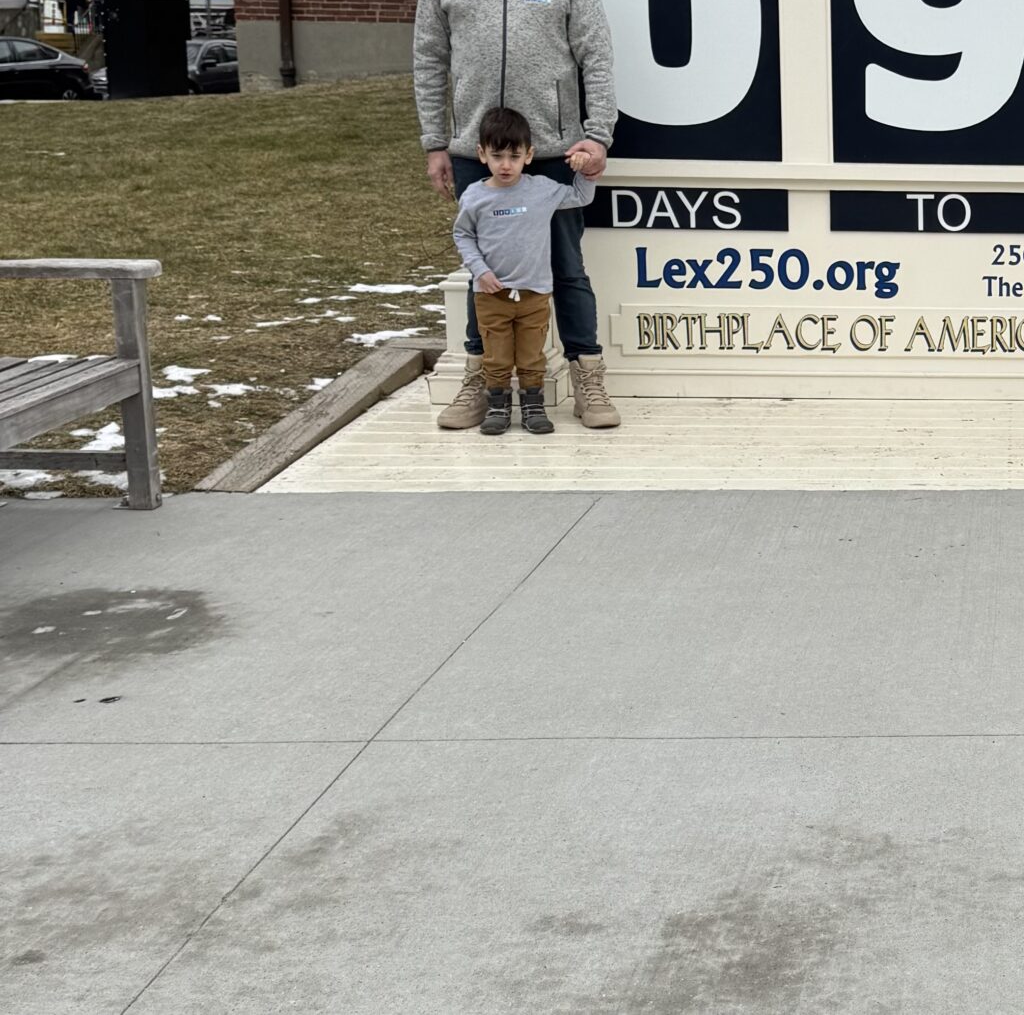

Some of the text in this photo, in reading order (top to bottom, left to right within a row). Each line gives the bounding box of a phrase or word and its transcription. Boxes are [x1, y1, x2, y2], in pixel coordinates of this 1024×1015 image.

[610, 189, 742, 230] DAYS
[906, 193, 972, 231] TO
[635, 247, 900, 299] Lex250.org
[982, 276, 1024, 298] The
[637, 313, 842, 353] BIRTHPLACE
[849, 314, 896, 352] OF
